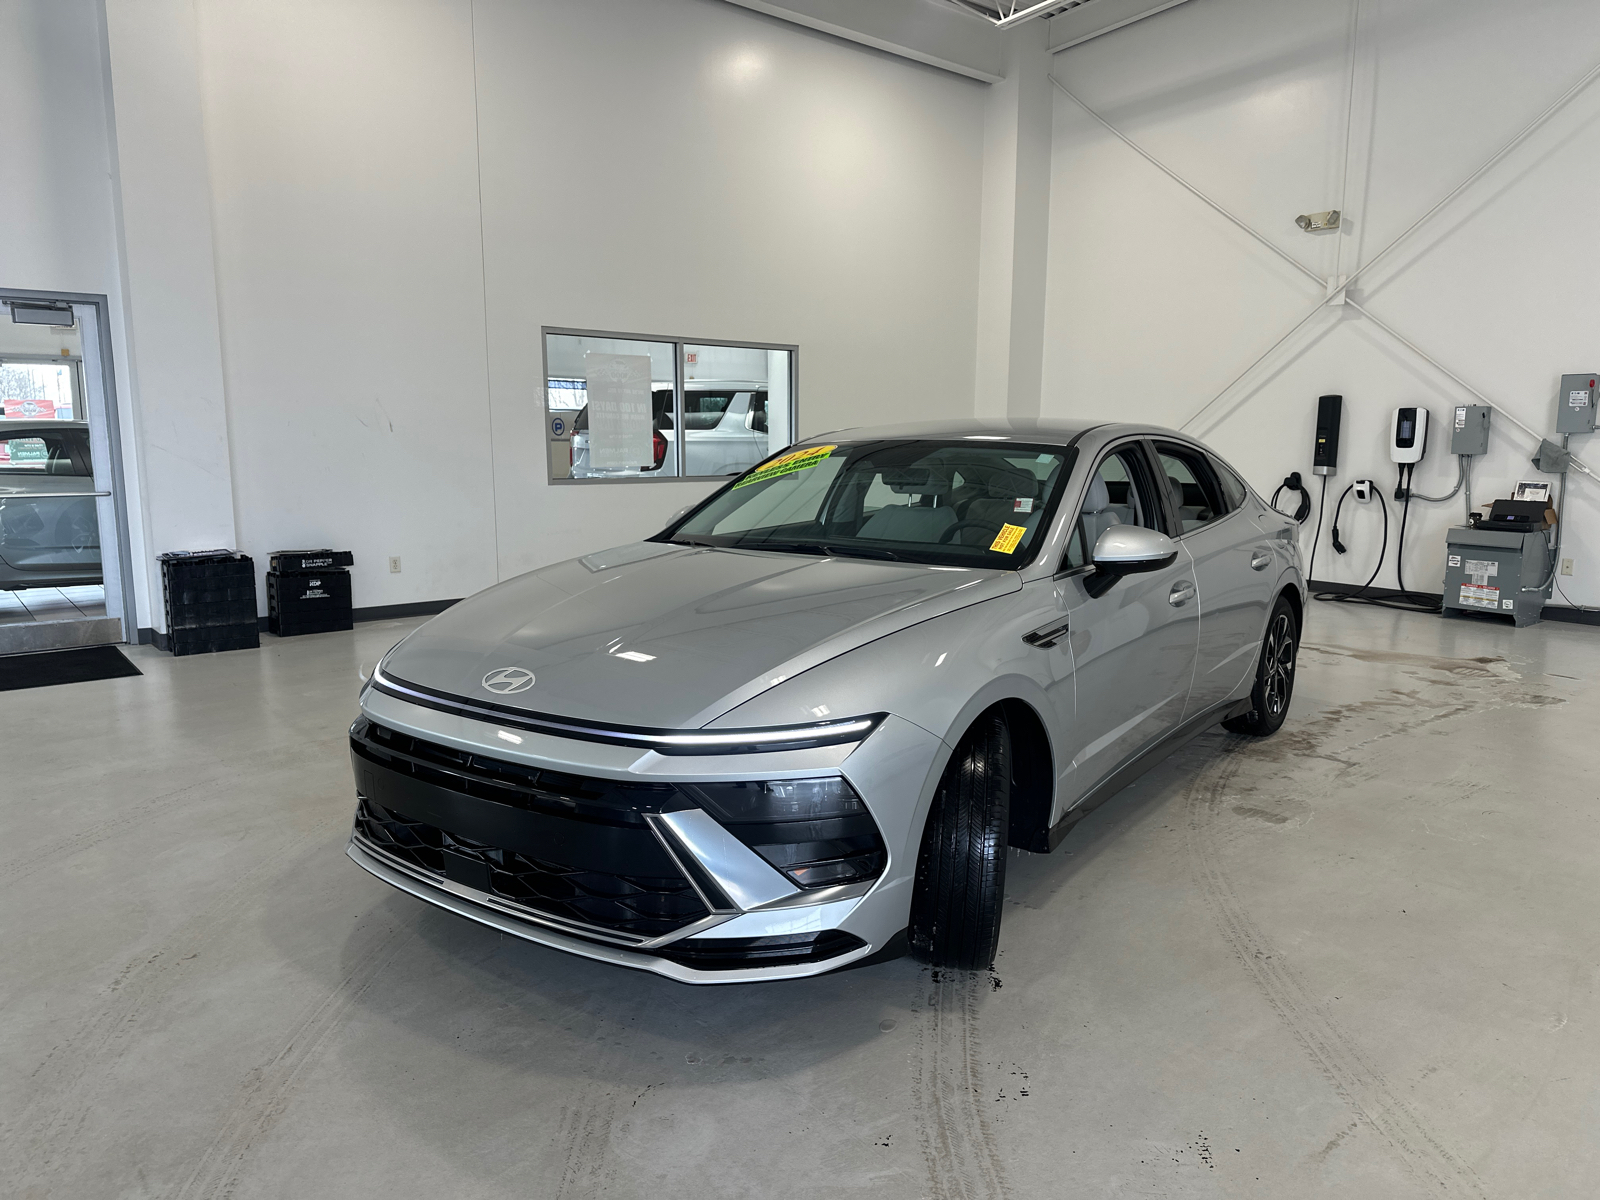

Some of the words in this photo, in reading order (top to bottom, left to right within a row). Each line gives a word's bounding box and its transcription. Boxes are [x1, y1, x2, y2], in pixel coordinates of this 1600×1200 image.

[687, 354, 696, 362] EXIT
[792, 452, 830, 466] ENTRY
[779, 459, 819, 474] CAMERA
[992, 541, 1000, 549] THIS
[998, 526, 1010, 540] VEHICLE
